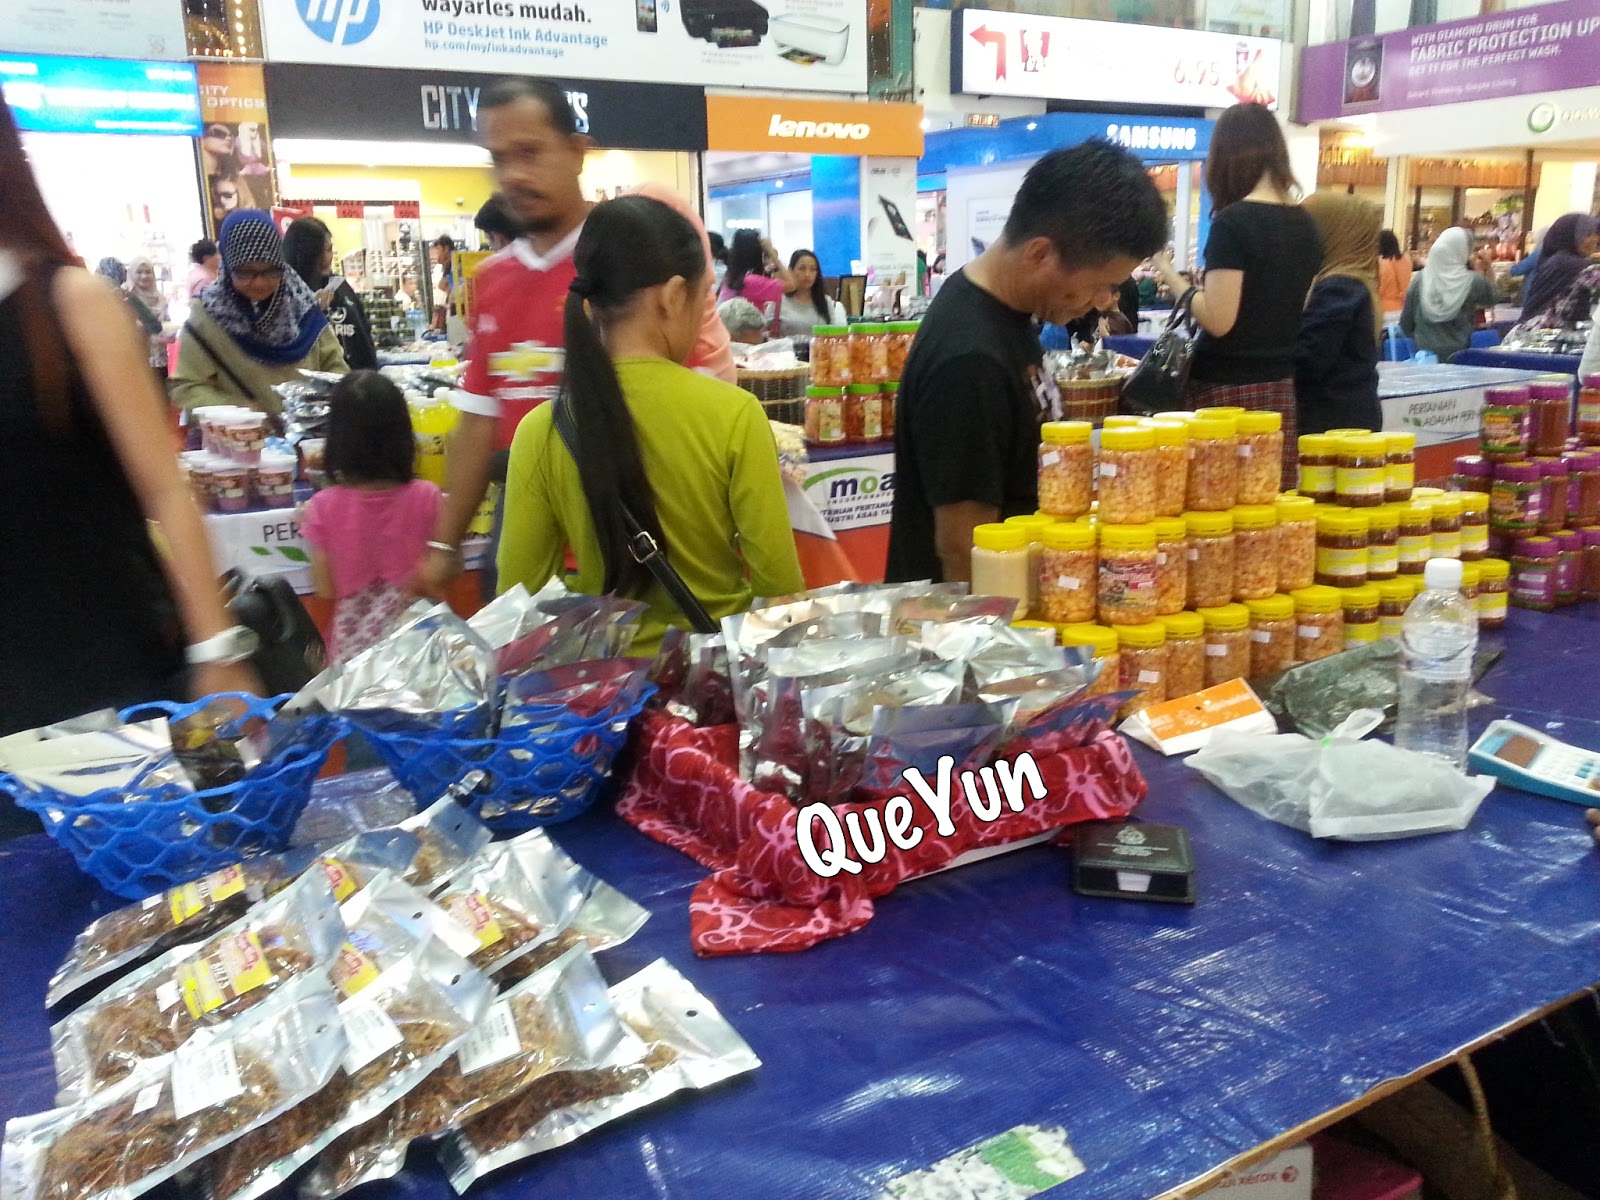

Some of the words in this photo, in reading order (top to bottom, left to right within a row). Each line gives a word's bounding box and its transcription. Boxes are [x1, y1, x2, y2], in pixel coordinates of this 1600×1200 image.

[519, 3, 592, 23] mudah.
[423, 22, 443, 34] HP
[448, 24, 505, 39] DeskJet
[509, 28, 530, 41] Ink
[535, 29, 608, 48] Advantage
[1411, 33, 1435, 46] WITH
[1436, 24, 1483, 42] DIAMOND
[1517, 13, 1539, 27] FOR
[424, 39, 565, 58] hp.com/my/inkadvantage
[1411, 40, 1464, 63] FABRIC
[1467, 20, 1573, 55] PROTECTION
[1462, 55, 1479, 69] THE
[1482, 49, 1526, 66] PERFECT
[206, 97, 265, 109] OPTICS
[421, 85, 480, 131] CITY
[768, 114, 870, 140] lenovo
[1106, 123, 1197, 150] SAMSUNG
[830, 472, 894, 498] moa
[820, 507, 853, 516] TERIAN
[855, 501, 893, 512] PERTANIA
[827, 491, 892, 505] INCORPORATE
[262, 521, 304, 542] PER
